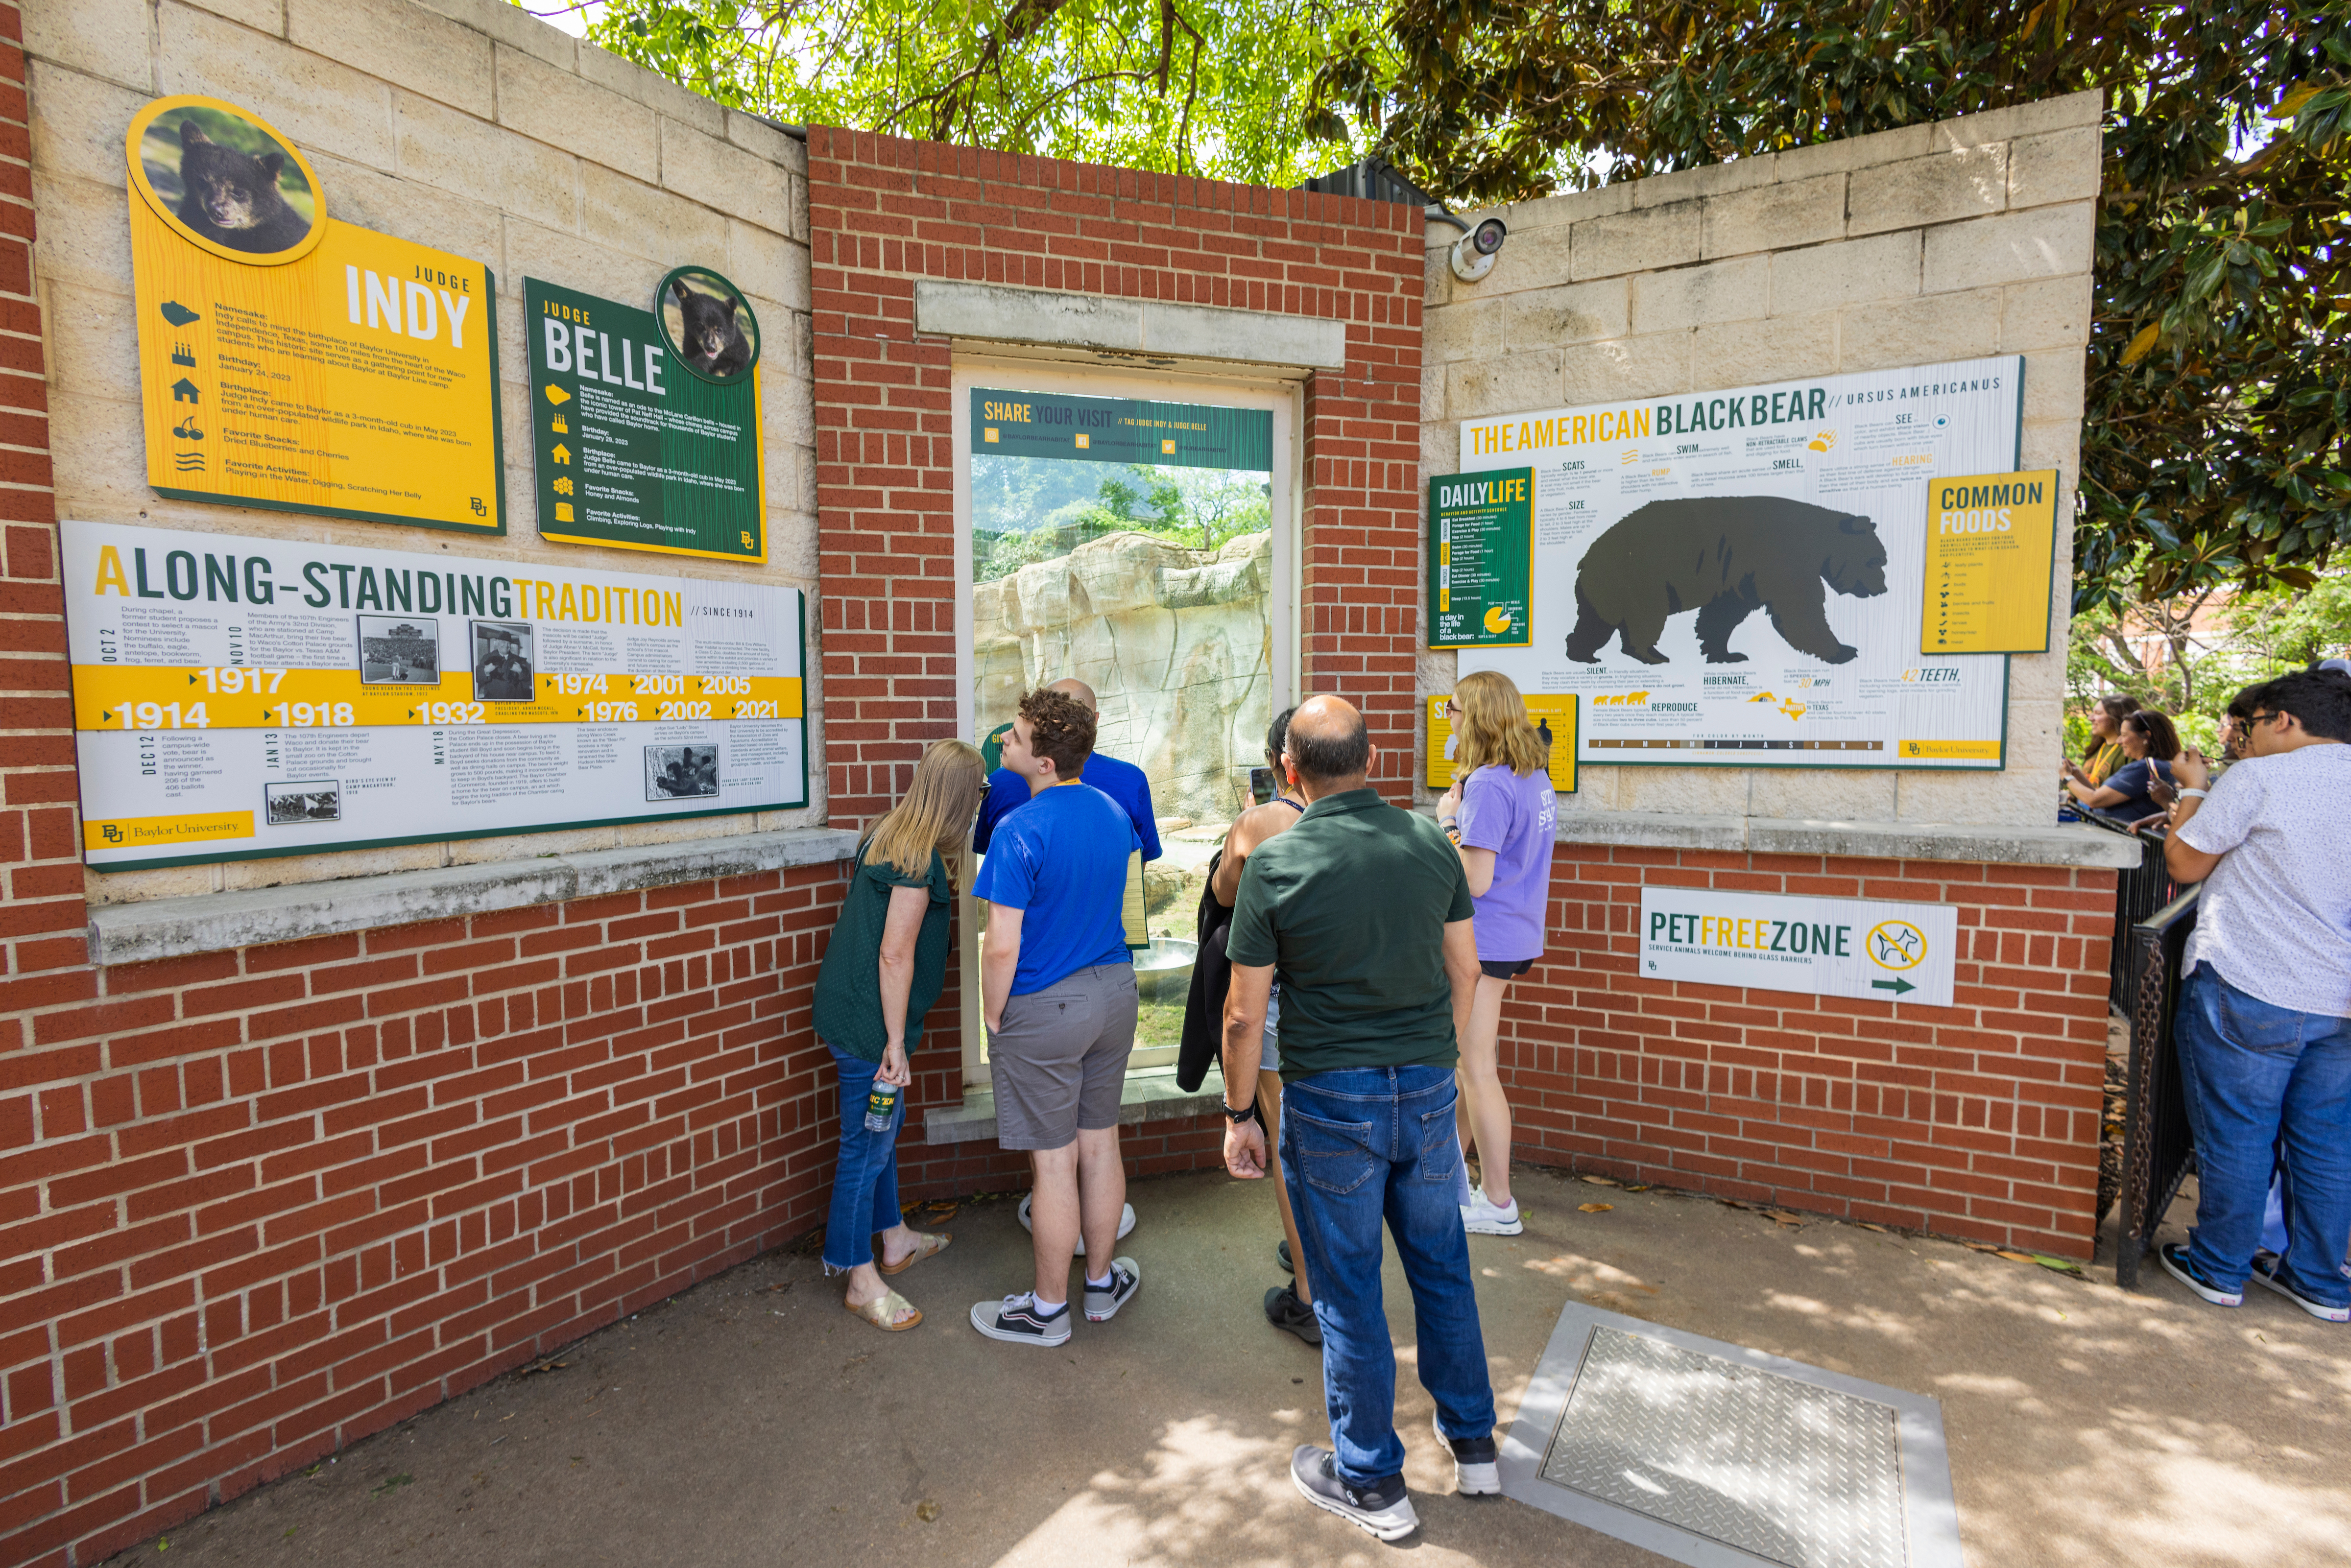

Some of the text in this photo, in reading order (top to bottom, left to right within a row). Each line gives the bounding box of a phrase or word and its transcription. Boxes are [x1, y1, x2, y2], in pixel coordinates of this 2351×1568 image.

[415, 266, 469, 292] JUDGE
[215, 303, 267, 319] Namesake:
[346, 265, 470, 348] INDY
[544, 300, 590, 325] JUDGE
[218, 354, 260, 368] Birthday:
[545, 318, 666, 396] BELLE
[219, 362, 291, 381] January 24, 2023
[220, 382, 270, 396] Birthplace:
[580, 385, 613, 397] Namesake:
[984, 402, 1031, 422] SHARE
[1657, 397, 1745, 435] BLACK
[1751, 389, 1825, 425] BEAR
[1847, 390, 1893, 404] URSUS
[1900, 378, 1999, 398] AMERICANUS
[1036, 406, 1112, 428] YOUR VISIT
[1896, 414, 1912, 424] SEE
[223, 428, 299, 445] Favorite Snacks:
[582, 426, 609, 437] Birthday:
[582, 432, 604, 442] January
[224, 436, 247, 445] Dried
[250, 440, 297, 452] Blueberries
[316, 450, 349, 460] Cherries
[583, 448, 615, 460] Birthplace:
[1677, 444, 1698, 454] SWIM
[225, 459, 309, 475] Favorite Activities:
[1563, 461, 1584, 471] SCATS
[1773, 459, 1802, 469] SMELL,
[1891, 453, 1933, 467] HEARING
[1651, 467, 1671, 477] RUMP
[226, 467, 257, 478] Playing
[285, 475, 310, 484] Water,
[313, 479, 345, 489] Digging,
[348, 484, 387, 495] Scratching
[405, 491, 421, 499] Belly
[1569, 500, 1584, 510] SIZE
[1941, 482, 2043, 509] COMMON
[586, 508, 640, 521] Favorite Activities:
[1940, 508, 2012, 535] FOODS
[121, 606, 146, 615] During
[1445, 614, 1457, 622] day
[102, 640, 117, 662] OCT
[229, 626, 244, 665] NOV 10
[199, 667, 287, 694] 1917
[552, 673, 609, 695] 1974
[1704, 676, 1748, 685] HIBERNATE,
[1799, 678, 1811, 688] 30
[1902, 668, 1960, 681] 42 TEETH,
[634, 675, 686, 695] 2001
[702, 676, 751, 695] 2005
[114, 701, 210, 730] 1914
[273, 701, 355, 727] 1918
[416, 702, 485, 725] 1932
[583, 700, 639, 722] 1976
[659, 701, 712, 721] 2002
[735, 700, 779, 719] 2021
[140, 736, 156, 775] DEC 12
[265, 734, 280, 768] JAN 13
[433, 731, 445, 764] MAY 18
[134, 826, 173, 837] Baylor
[176, 823, 238, 833] University
